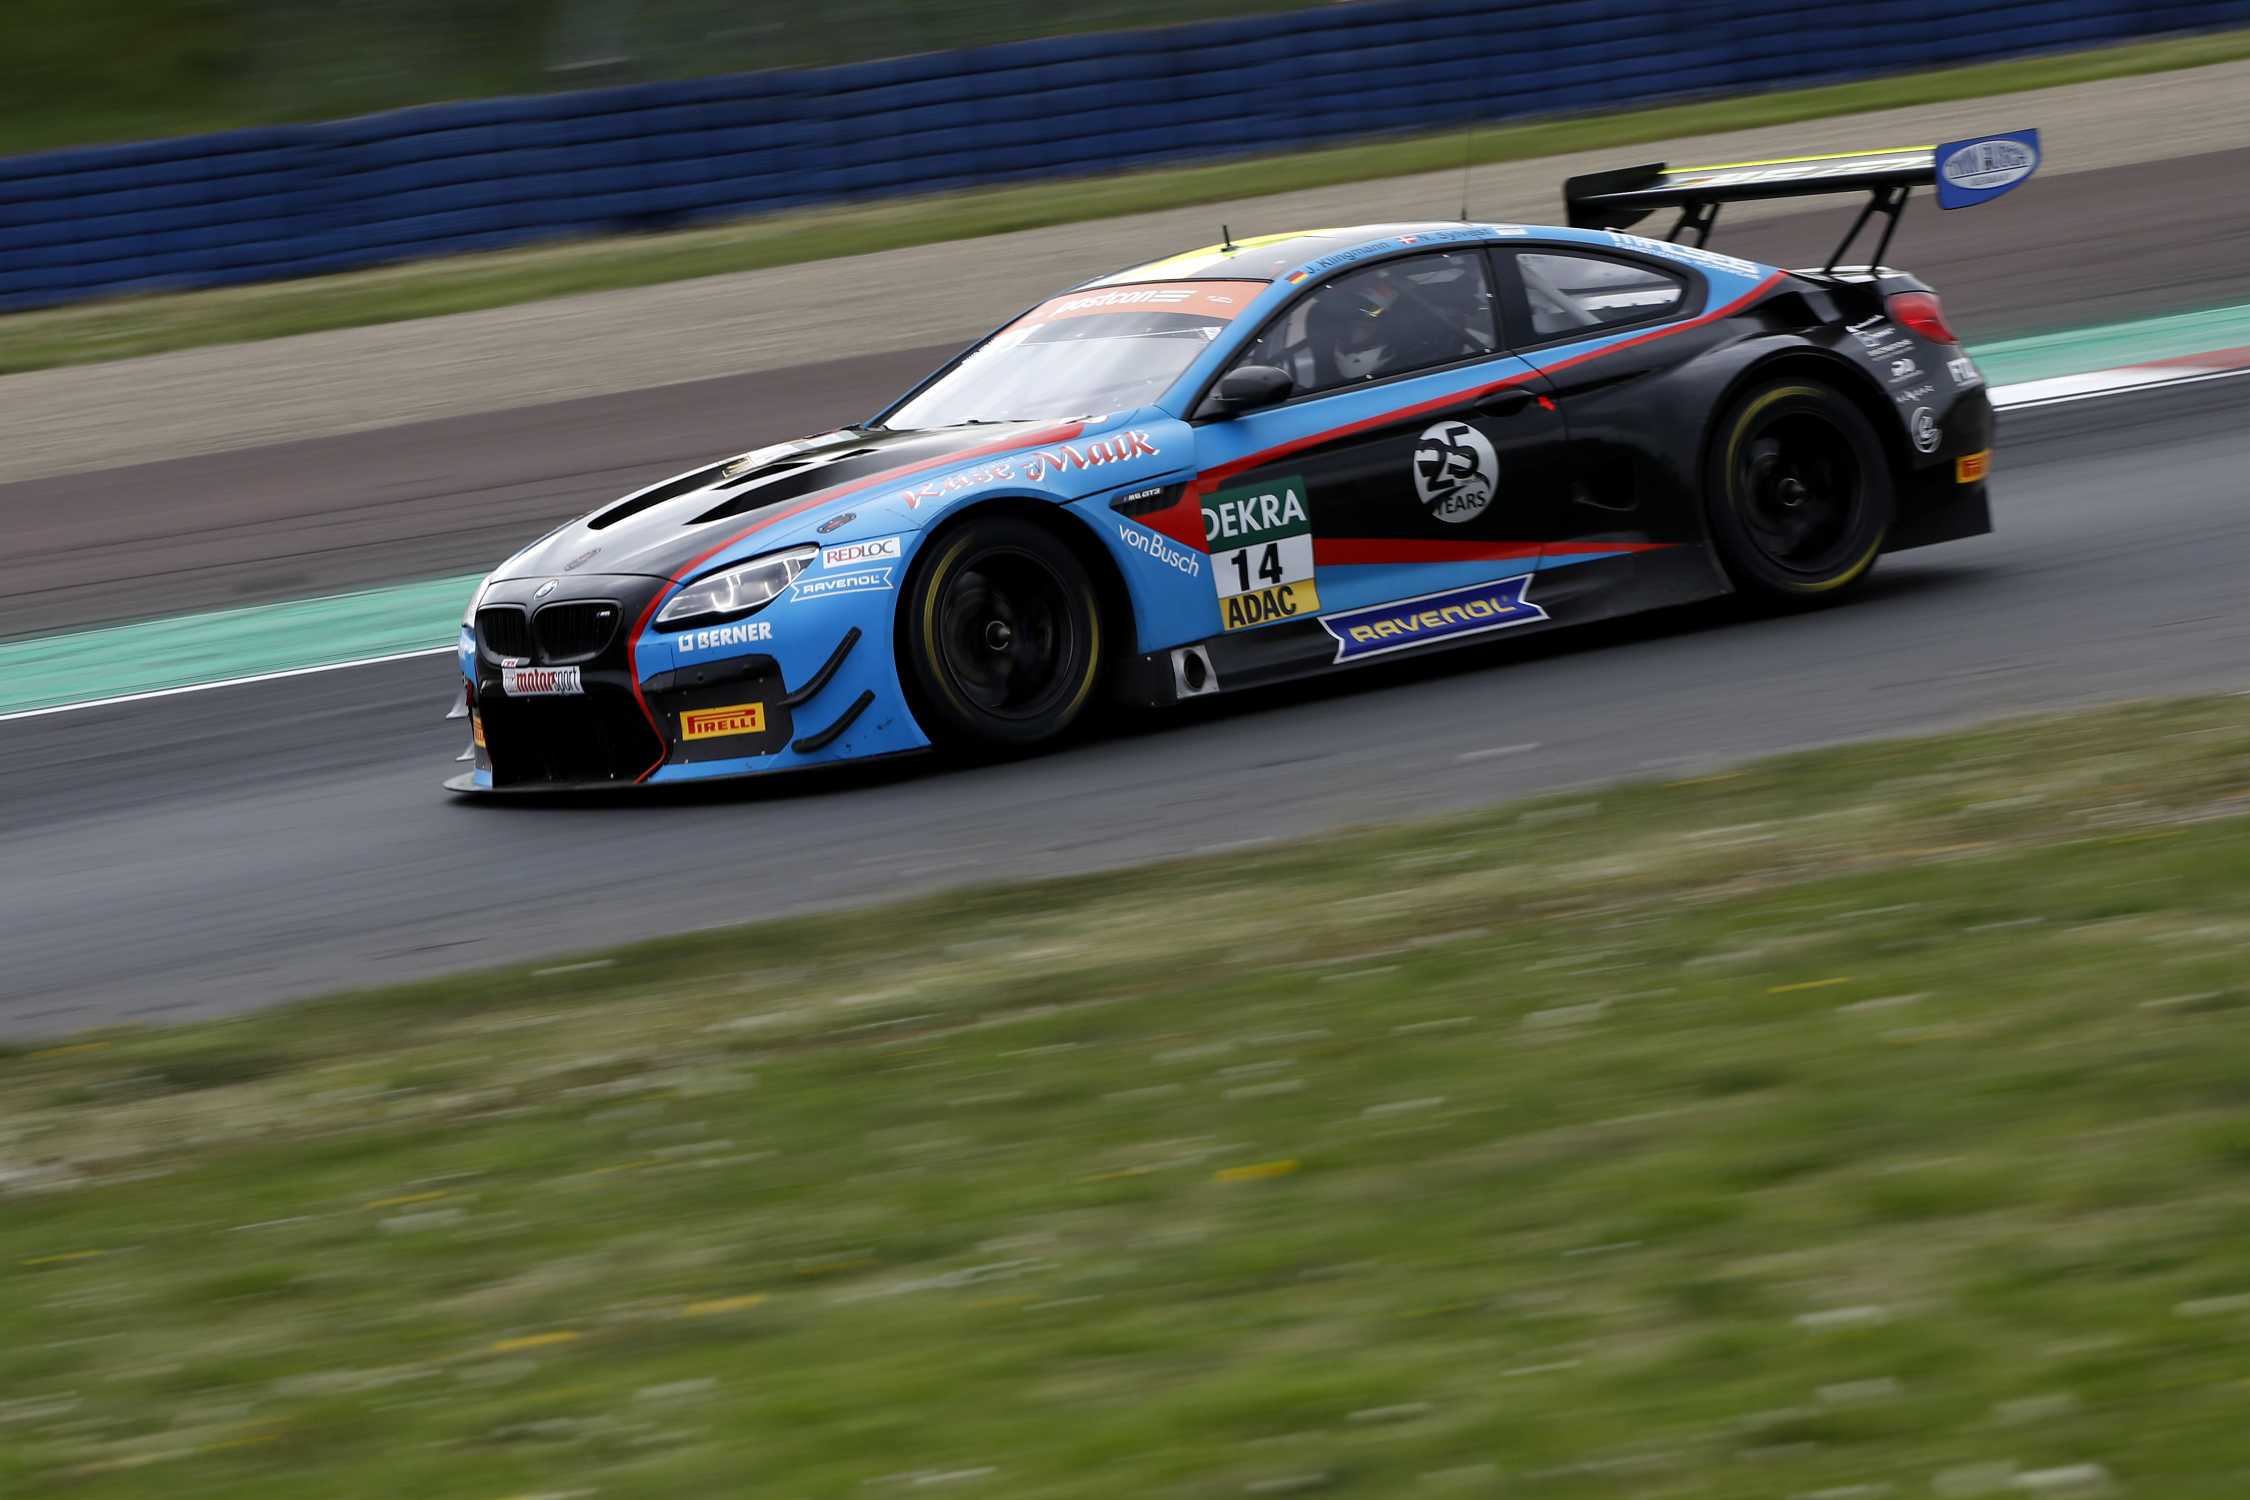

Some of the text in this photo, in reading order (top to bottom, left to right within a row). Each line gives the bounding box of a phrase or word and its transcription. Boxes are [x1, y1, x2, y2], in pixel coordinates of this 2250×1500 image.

[1318, 241, 1392, 269] Klingmann
[1417, 425, 1480, 492] 25
[1200, 488, 1307, 542] DEKRA
[827, 540, 894, 564] REDLOC
[1231, 542, 1283, 592] 14
[803, 575, 880, 594] RAVENOL
[1228, 585, 1297, 628] ADAC
[1350, 596, 1516, 643] RAVENOL
[697, 621, 773, 649] BERNER
[516, 665, 581, 695] motorsport
[686, 708, 756, 735] PIRELLI
